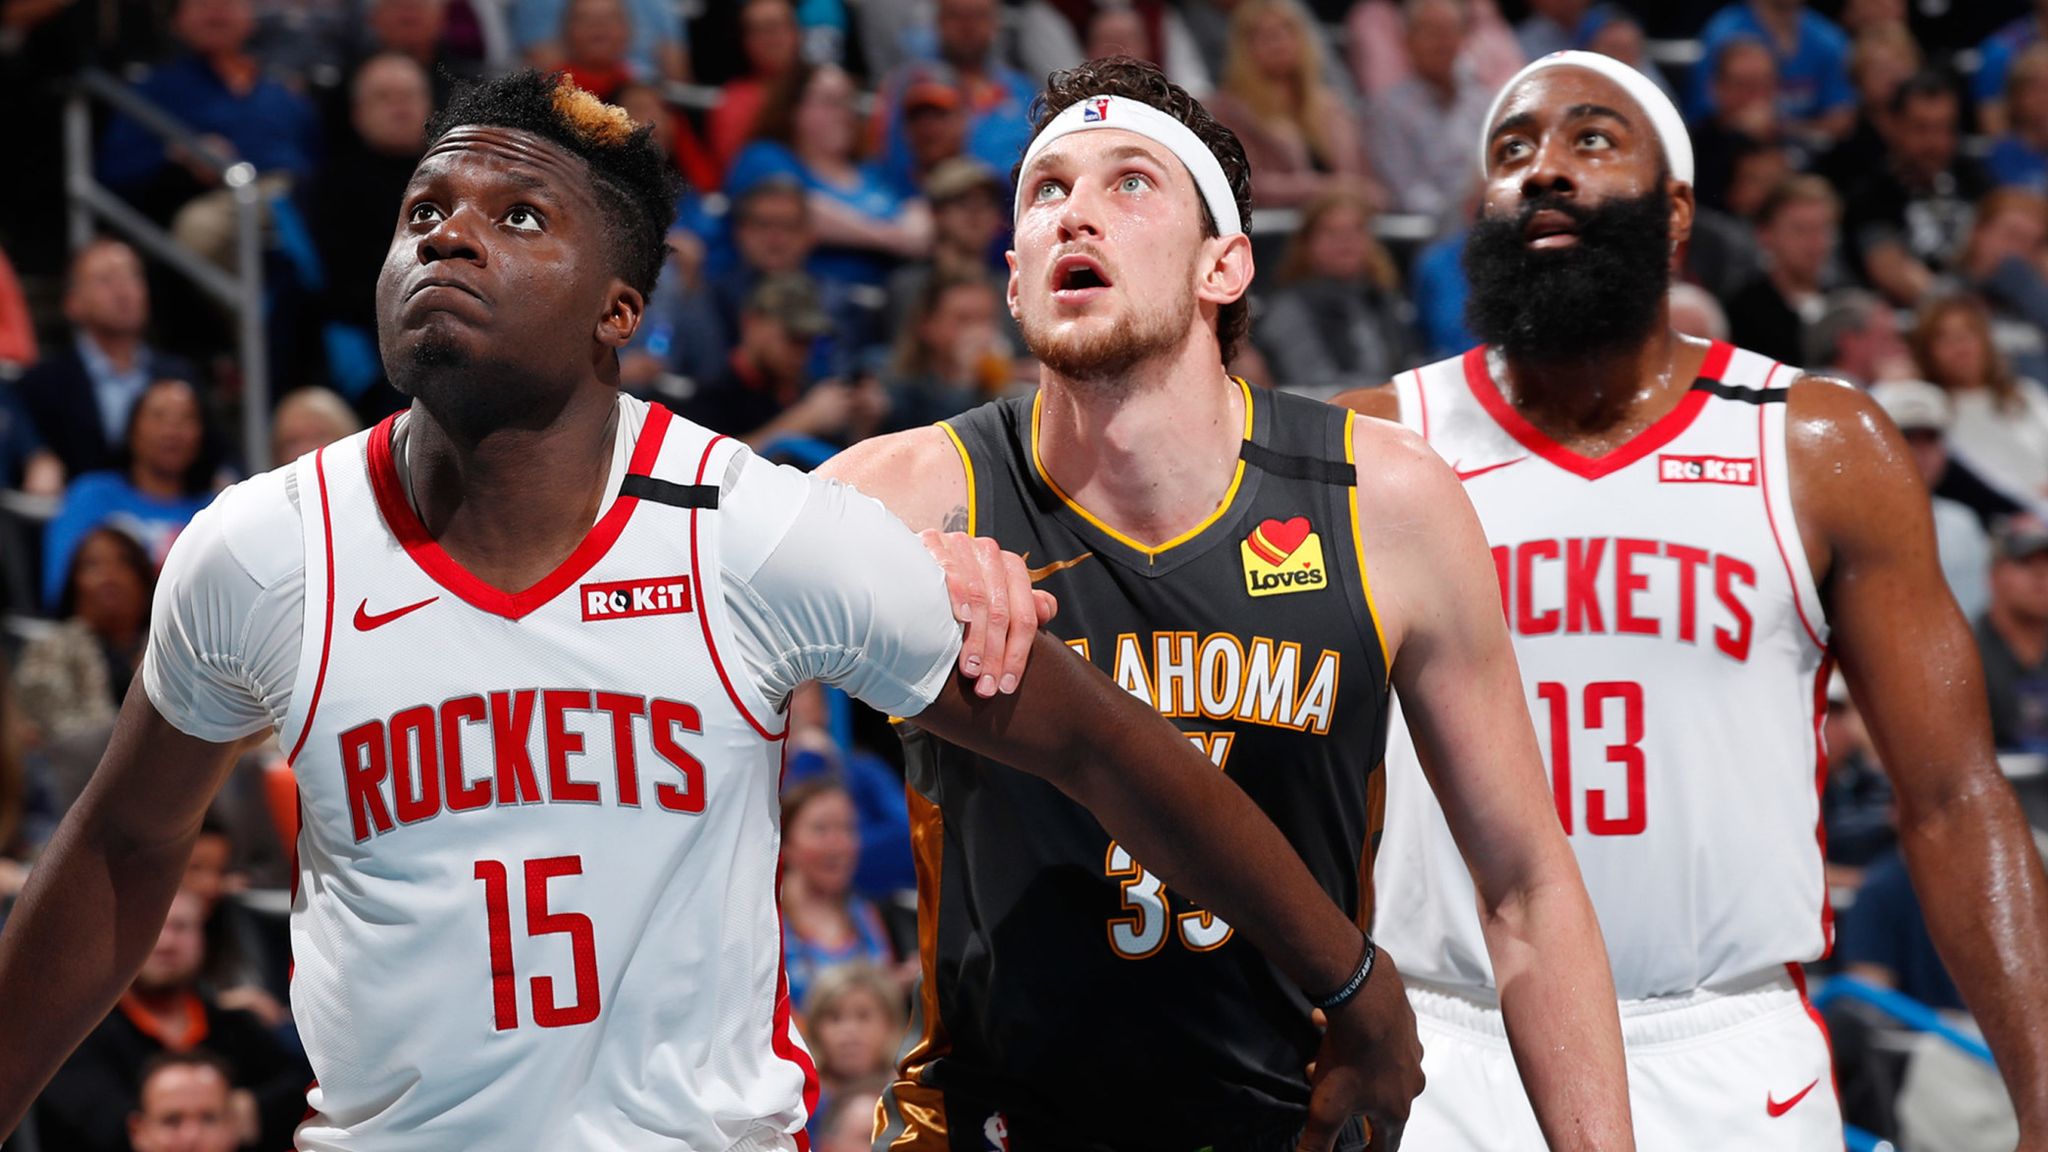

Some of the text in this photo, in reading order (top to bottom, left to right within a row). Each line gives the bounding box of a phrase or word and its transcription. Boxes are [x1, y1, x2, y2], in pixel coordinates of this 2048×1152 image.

[587, 584, 684, 616] ROKiT
[1064, 631, 1340, 736] AHOMA
[1537, 681, 1648, 837] 13
[338, 687, 707, 845] ROCKETS
[474, 855, 601, 1031] 15
